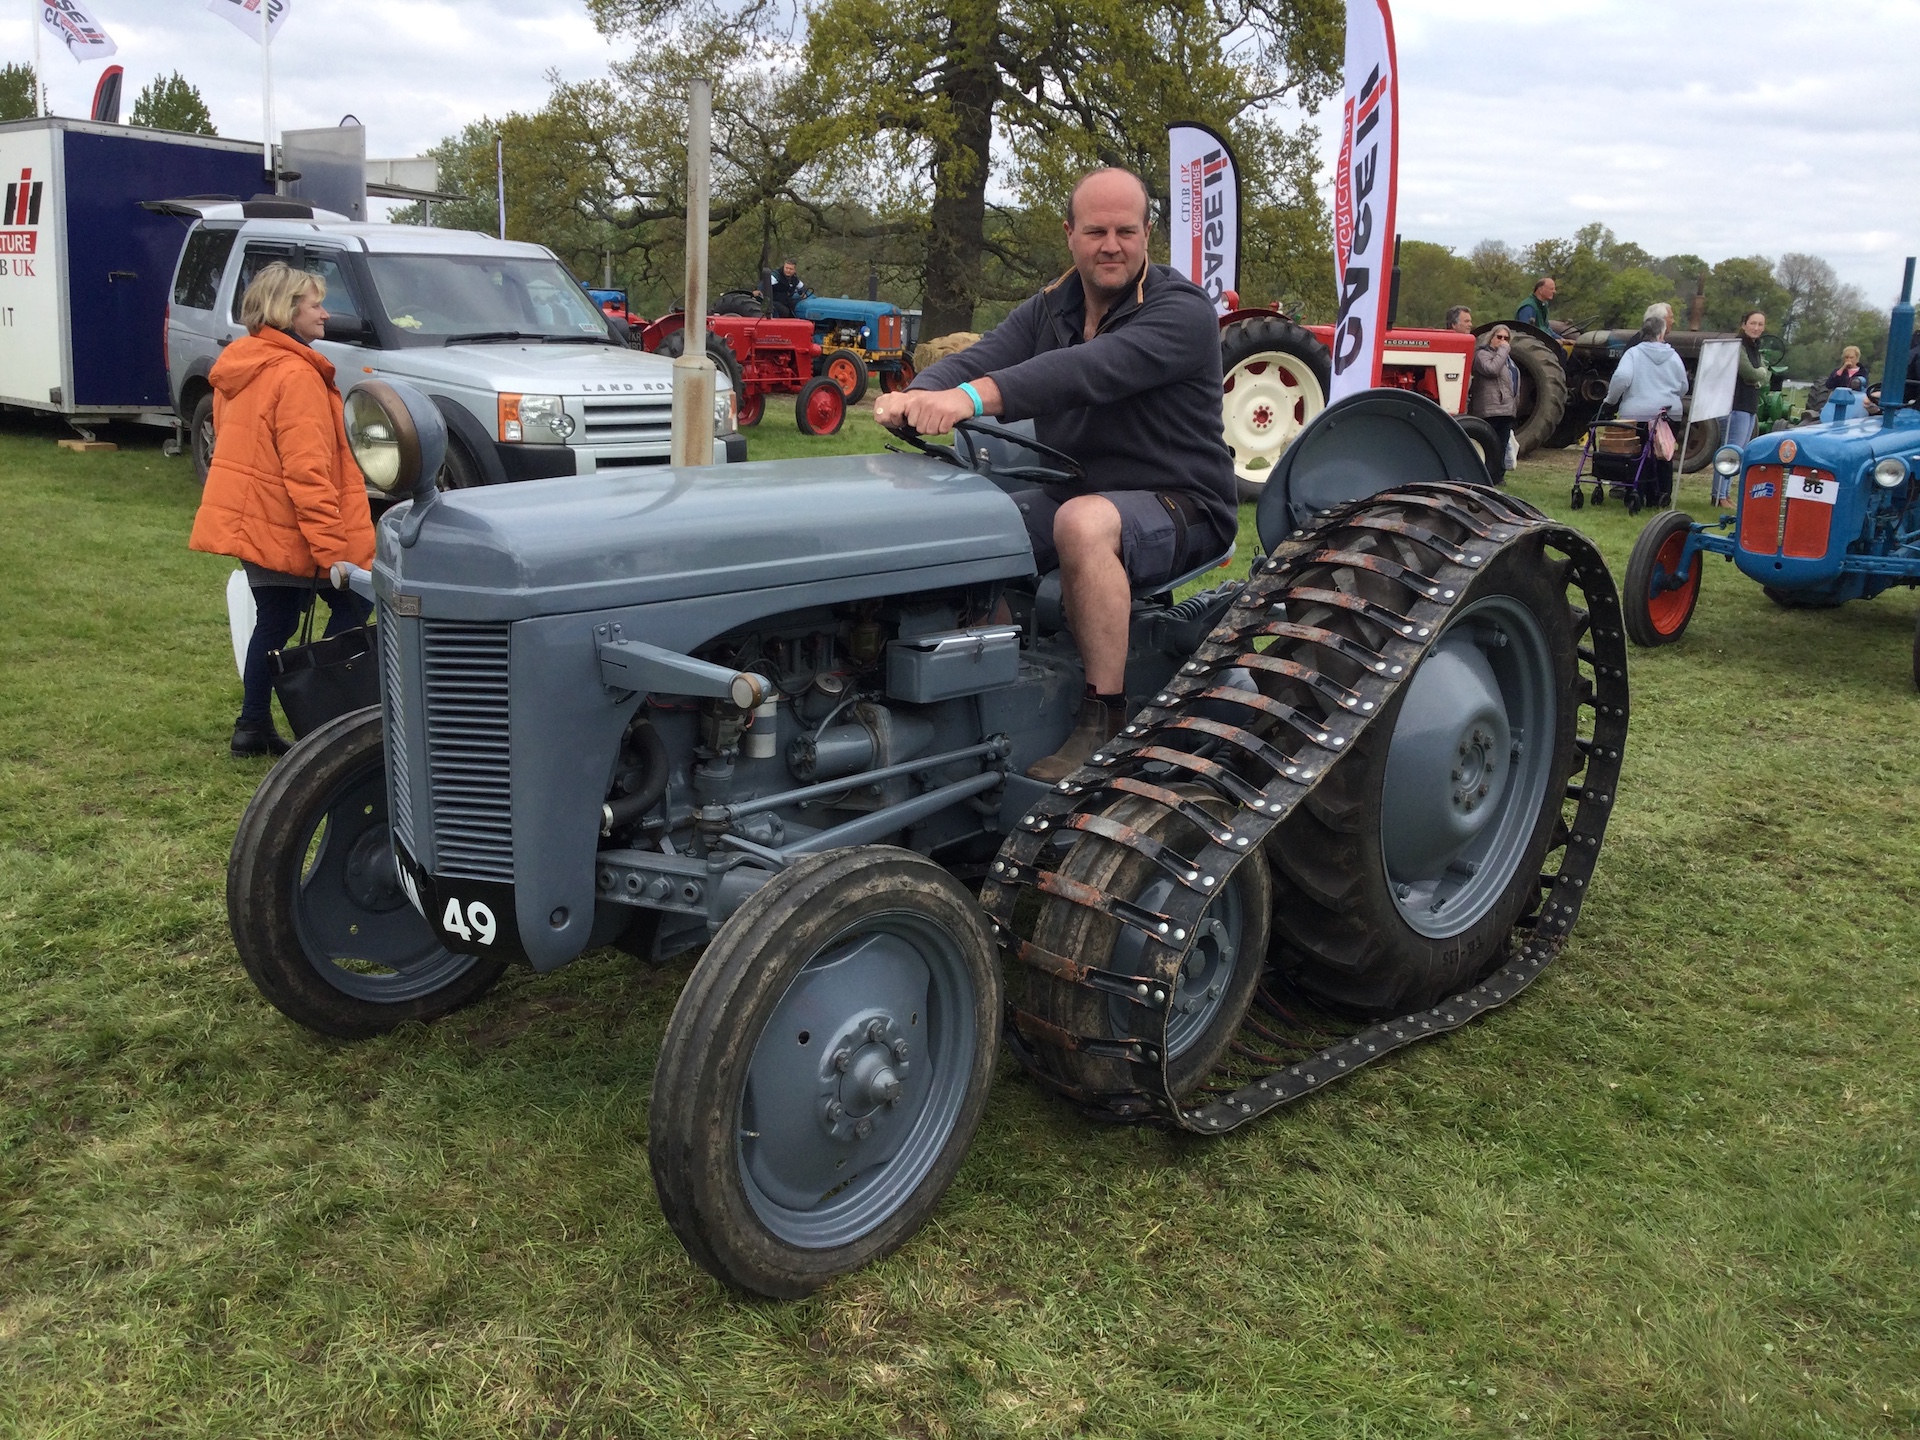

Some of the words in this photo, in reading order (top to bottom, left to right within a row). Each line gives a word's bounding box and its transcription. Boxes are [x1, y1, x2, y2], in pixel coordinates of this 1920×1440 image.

[12, 259, 36, 276] UK
[582, 383, 633, 392] LAND
[1802, 480, 1824, 494] 86
[442, 897, 497, 946] 49
